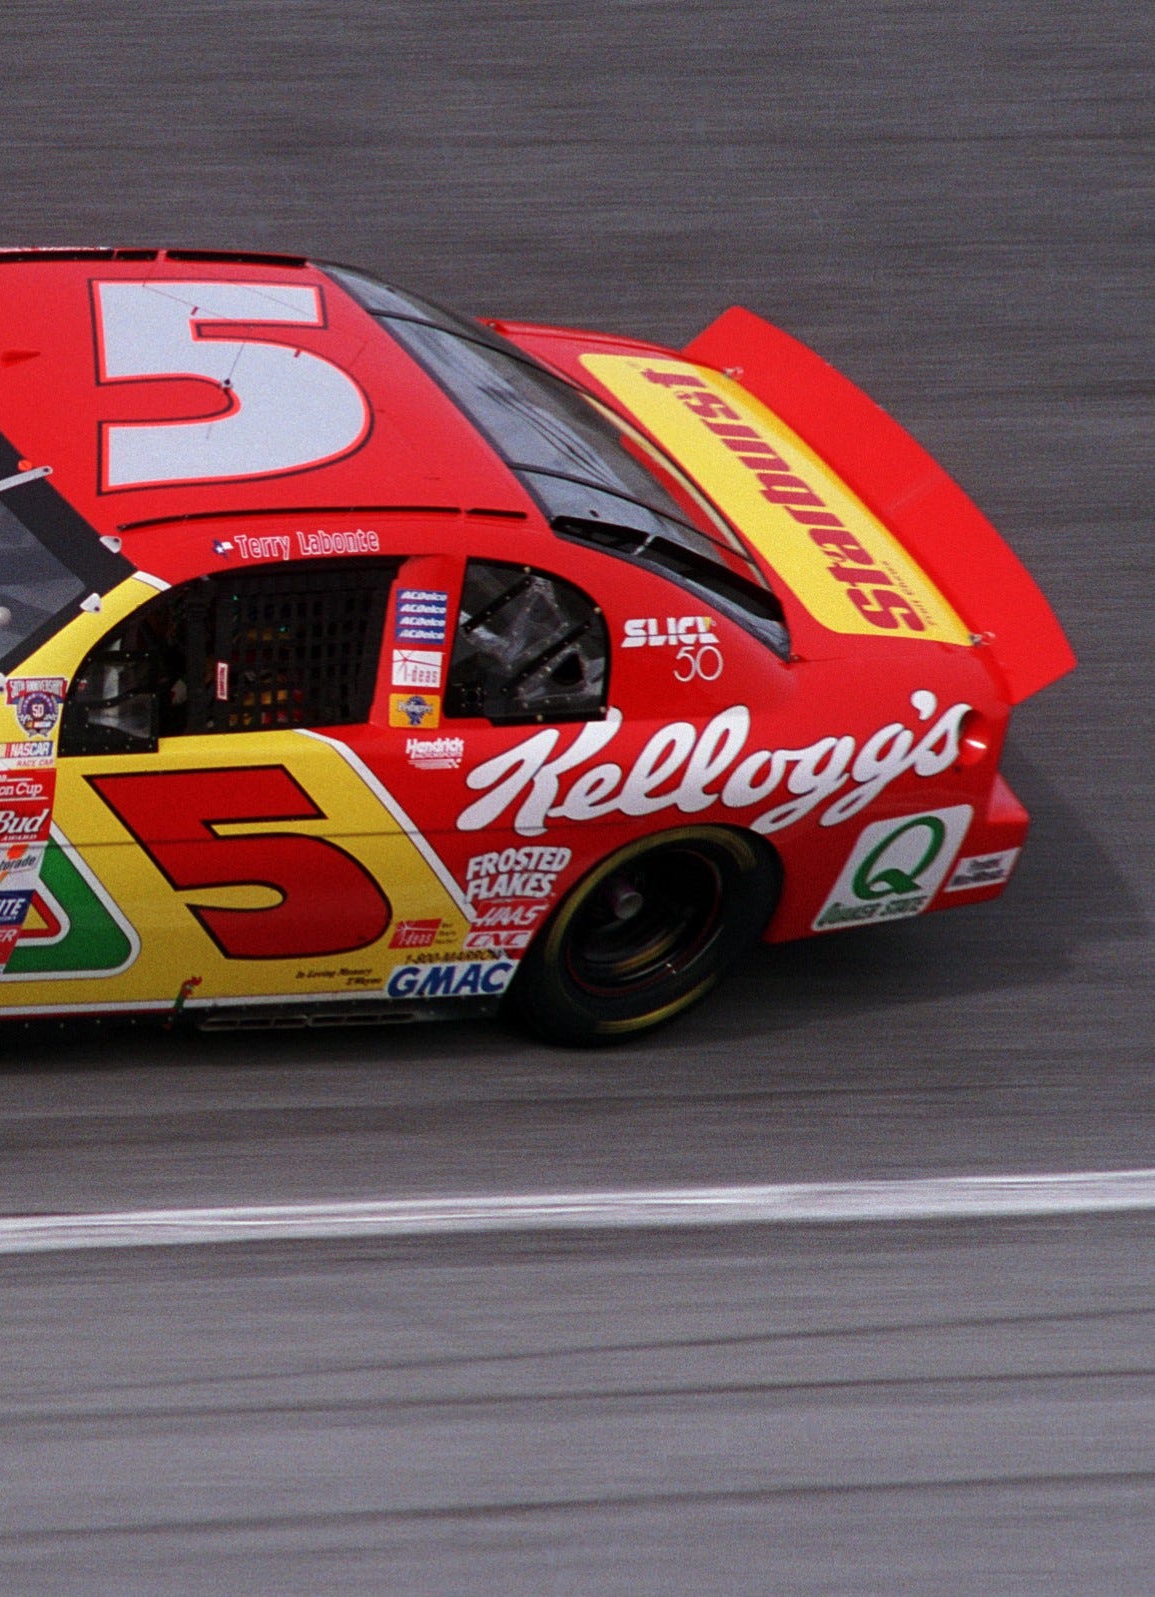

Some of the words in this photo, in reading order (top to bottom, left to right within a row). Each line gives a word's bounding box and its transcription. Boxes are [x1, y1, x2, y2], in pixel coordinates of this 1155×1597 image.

[88, 277, 375, 496] 5
[234, 534, 290, 560] Terry
[296, 529, 380, 555] Labonte
[621, 616, 719, 648] SLICK
[673, 645, 724, 682] 50
[10, 742, 52, 757] NASCAR
[39, 758, 54, 766] CAR
[456, 690, 972, 836] Kellogg's
[16, 782, 43, 797] Cup
[82, 764, 393, 959] 5
[466, 846, 572, 881] FROSTED
[852, 815, 945, 900] Q
[465, 873, 557, 904] FLAKES
[475, 904, 550, 926] HAAS
[387, 963, 514, 998] GMAC
